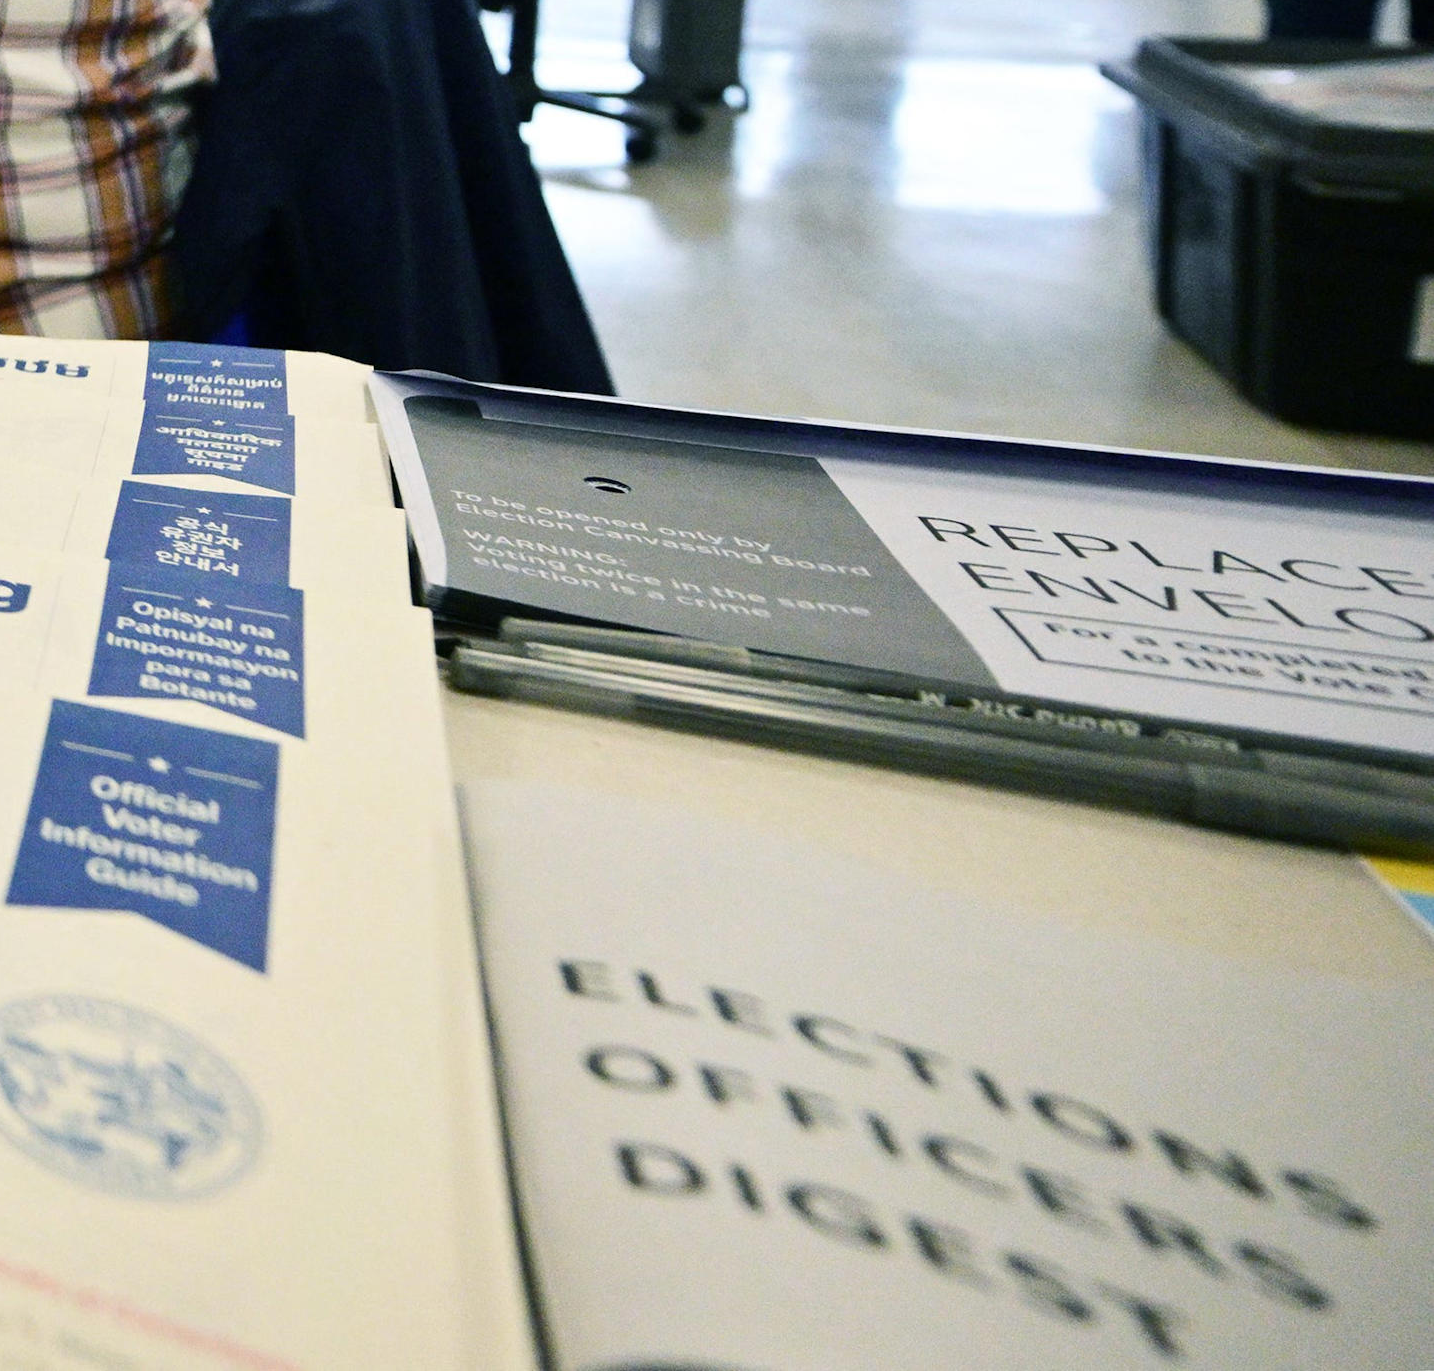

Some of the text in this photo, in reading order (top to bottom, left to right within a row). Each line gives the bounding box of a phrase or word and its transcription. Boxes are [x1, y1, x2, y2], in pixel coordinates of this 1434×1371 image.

[160, 526, 244, 550] 유권자
[175, 517, 228, 536] 공식
[450, 490, 772, 552] To be opened only by
[456, 503, 871, 578] Election Canvassing Board
[155, 550, 239, 577] 안내서
[172, 541, 226, 560] 정보
[464, 529, 628, 567] WARNING:
[917, 516, 1434, 599] REPLACE
[467, 542, 870, 617] Voting twice in the same
[473, 556, 771, 618] election is a crime
[116, 616, 291, 661] Patnubay na
[132, 601, 275, 639] Opisyal na
[106, 632, 299, 682] Impormasyon
[145, 660, 252, 690] para sa
[1045, 622, 1431, 682] For a completed
[1122, 650, 1171, 665] to
[1182, 656, 1265, 677] the
[139, 674, 257, 709] Botante
[90, 775, 220, 824] Official
[102, 803, 202, 846] Voter
[40, 817, 259, 893] Information
[85, 857, 200, 906] Guide
[557, 958, 1381, 1232] ELECTIONS
[582, 1044, 1330, 1311] OFFICERS
[614, 1139, 1188, 1364] DIGEST
